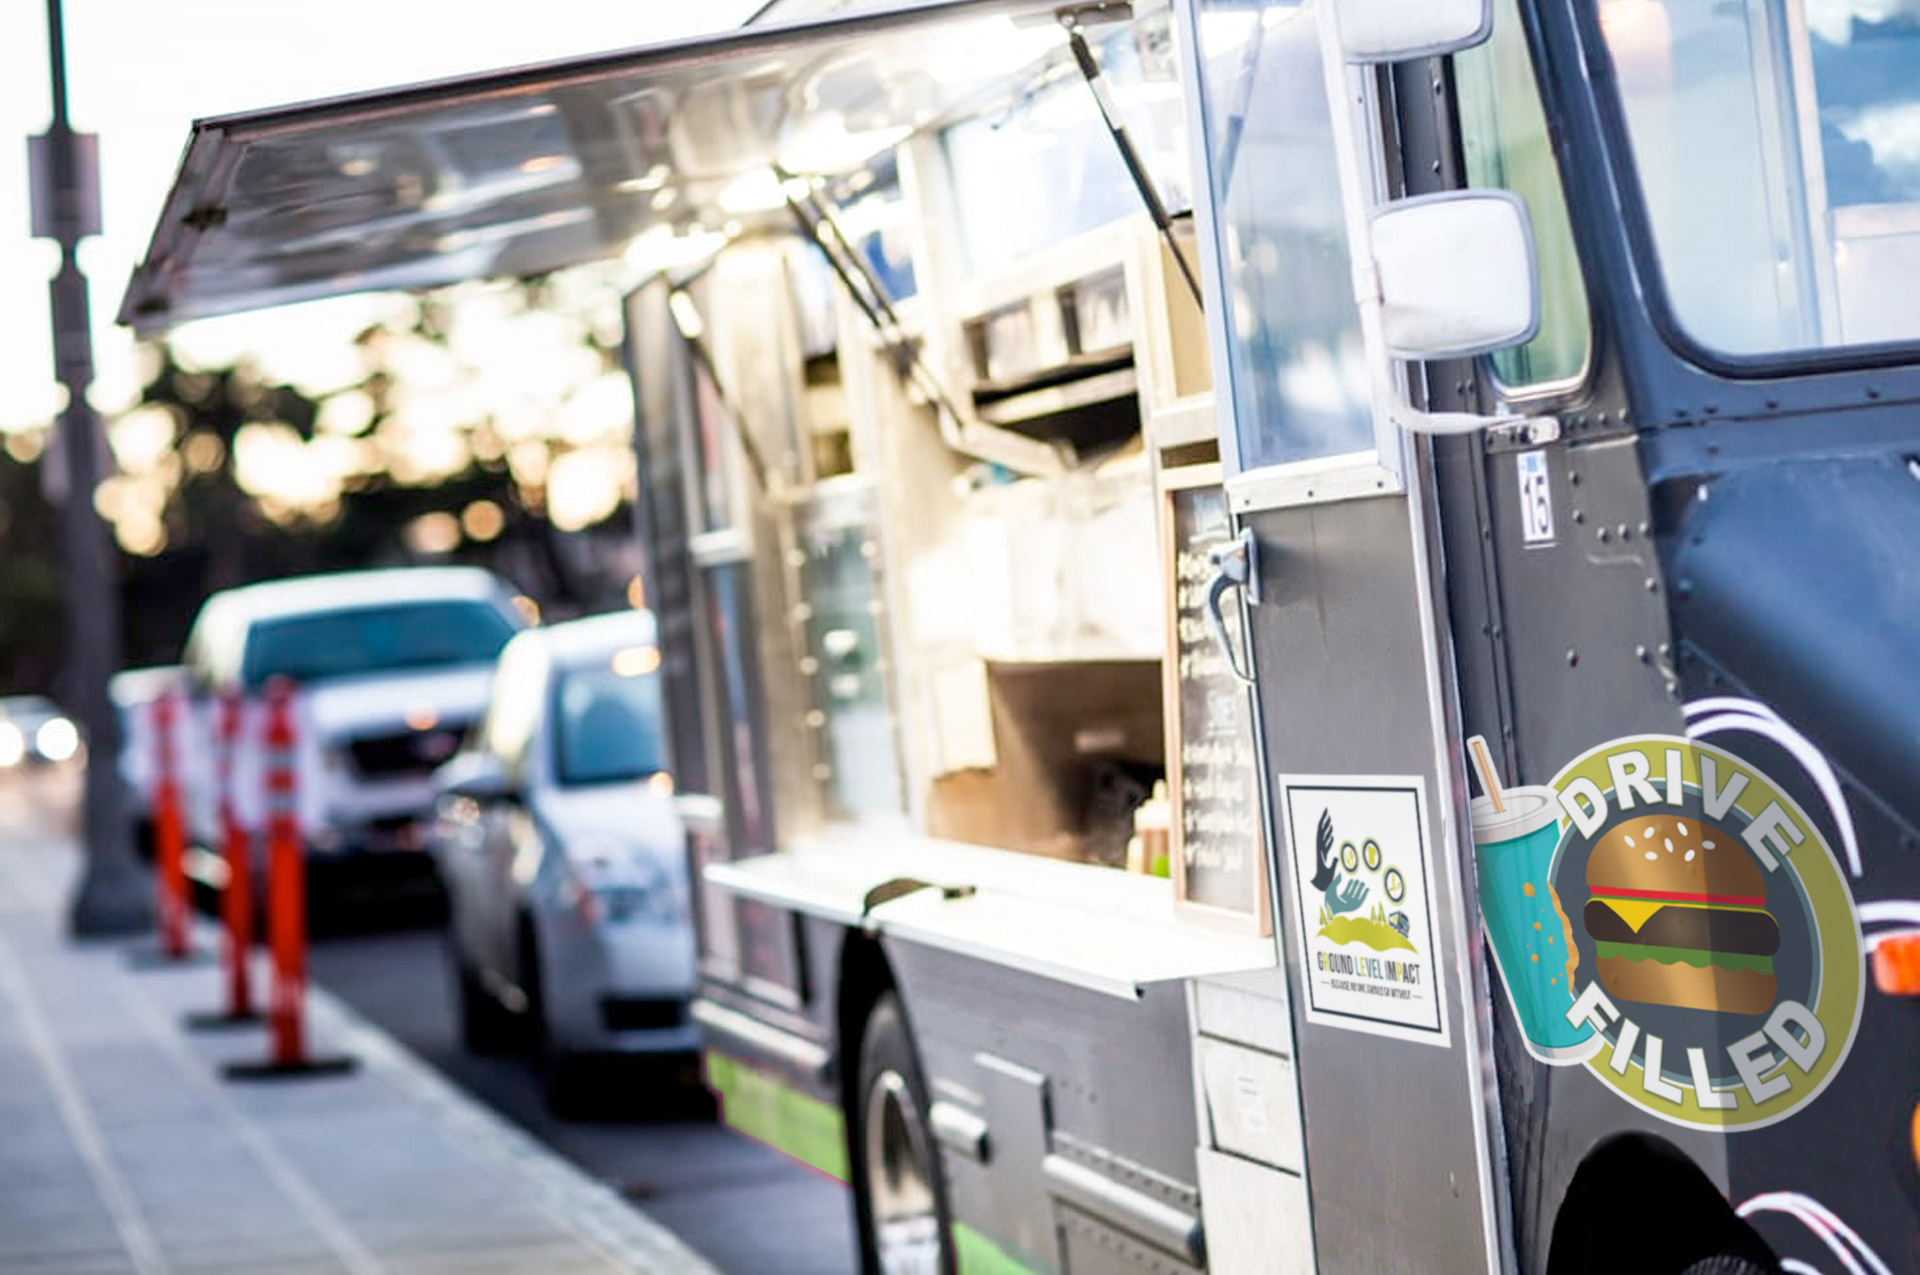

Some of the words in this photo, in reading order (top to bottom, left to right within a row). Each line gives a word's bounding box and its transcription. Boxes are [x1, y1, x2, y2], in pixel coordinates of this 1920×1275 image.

[1556, 748, 1805, 873] DRIVE
[1317, 951, 1353, 975] GROUND
[1354, 956, 1383, 979] LEVEL
[1384, 960, 1420, 985] IMPACT
[1565, 980, 1826, 1110] FILLED
